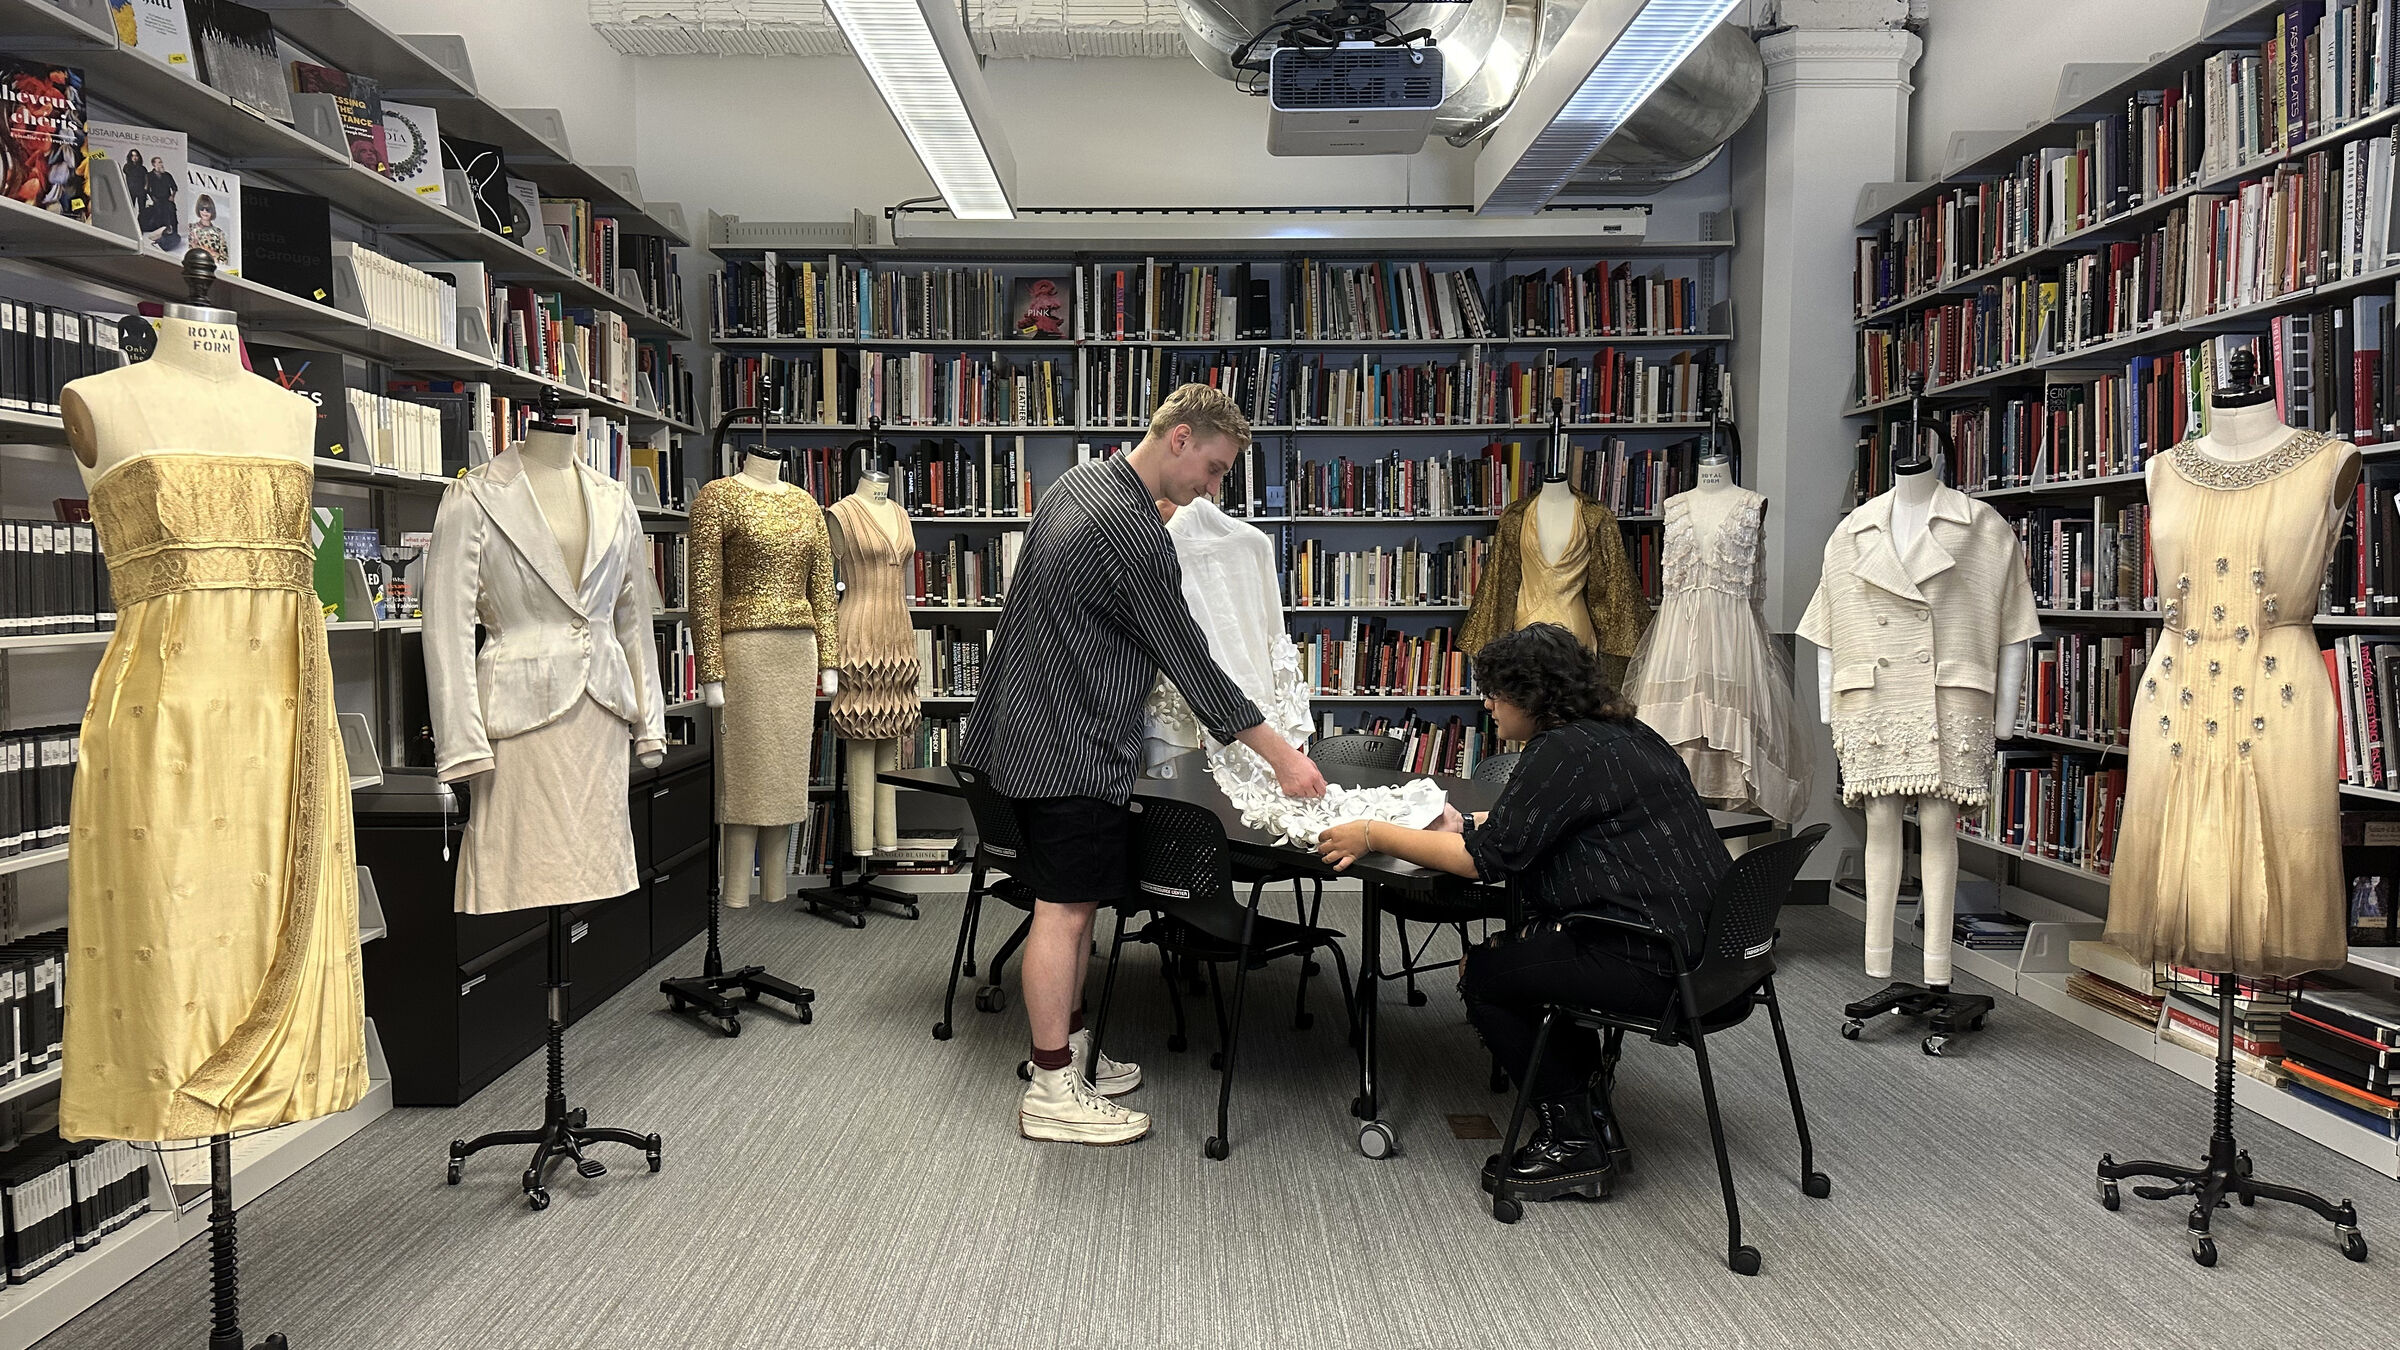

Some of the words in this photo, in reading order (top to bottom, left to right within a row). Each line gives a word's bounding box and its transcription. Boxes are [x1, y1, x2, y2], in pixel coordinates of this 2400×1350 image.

[2289, 25, 2299, 74] FASHION
[0, 84, 77, 110] heveux
[2278, 62, 2286, 109] POCHOIR
[2290, 75, 2299, 118] PLATES
[142, 135, 179, 147] FASHION
[187, 170, 229, 194] ANNA
[1027, 309, 1050, 317] PINK
[188, 326, 235, 341] ROYAL
[2272, 322, 2281, 361] HOLIDAY
[125, 344, 148, 354] Only
[130, 352, 144, 361] the
[193, 340, 231, 354] FORM
[2202, 344, 2211, 392] ISSUES
[1018, 386, 1026, 421] LEATHER
[2350, 660, 2359, 689] FARM
[2360, 645, 2373, 687] MARIO
[2063, 677, 2068, 685] of
[2365, 691, 2379, 742] TESTINO
[905, 850, 937, 858] BLAHNIK
